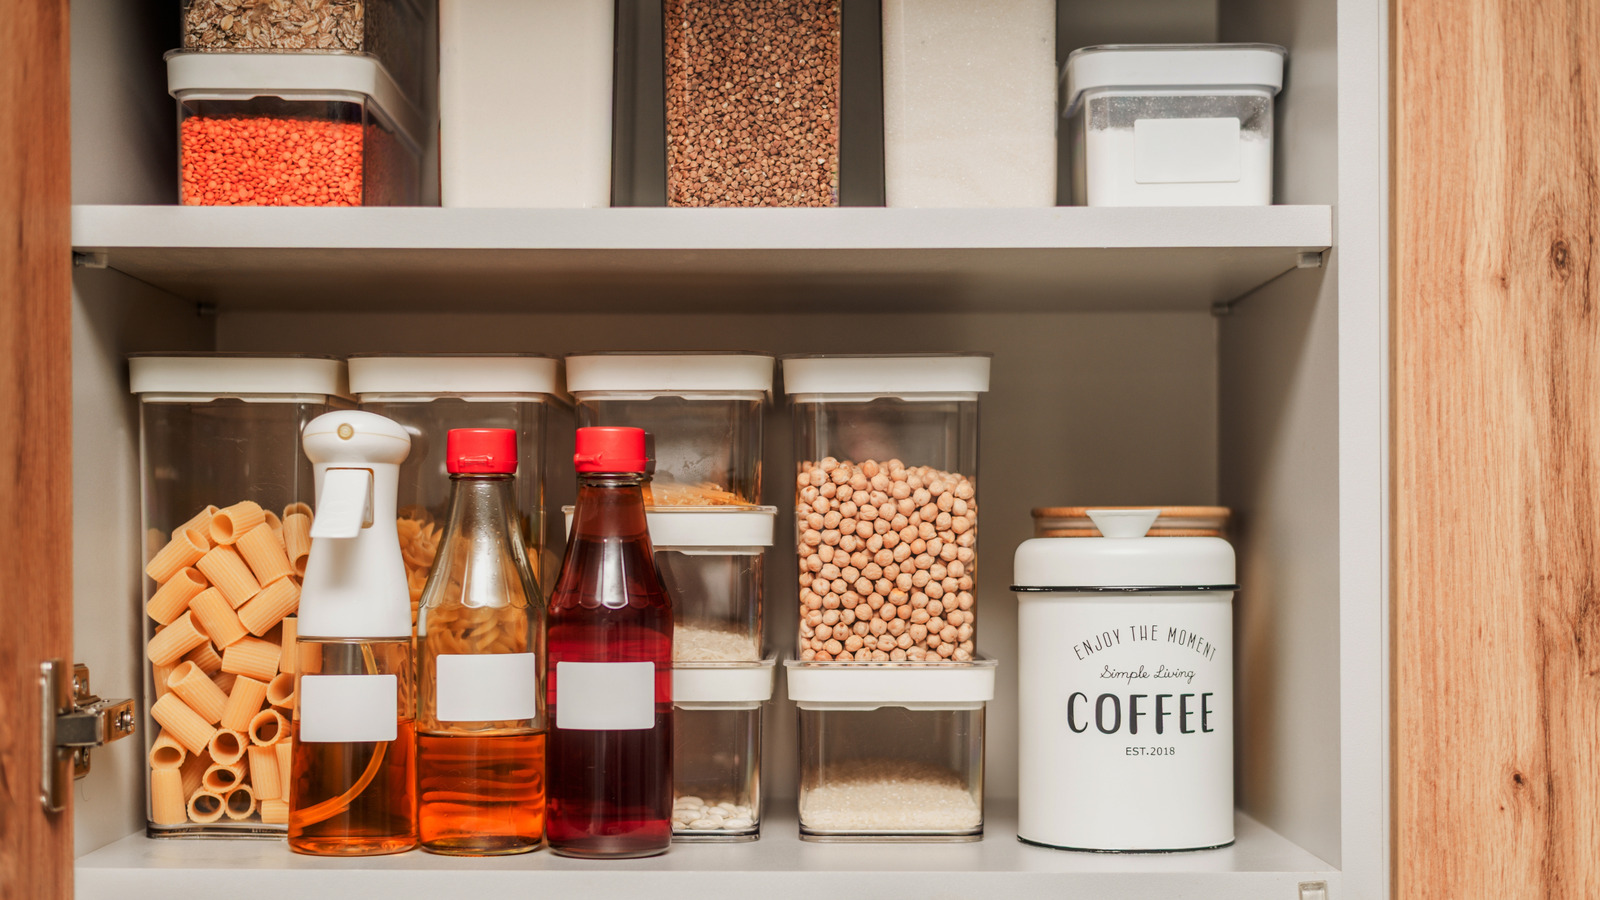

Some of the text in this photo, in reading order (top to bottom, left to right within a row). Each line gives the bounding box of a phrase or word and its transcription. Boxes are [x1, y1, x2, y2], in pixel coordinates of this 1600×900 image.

[1073, 624, 1217, 662] ENJOY THE MOMENT
[1100, 664, 1196, 685] Simple Living
[1067, 691, 1214, 735] COFFEE
[1125, 746, 1176, 756] EST.2018
